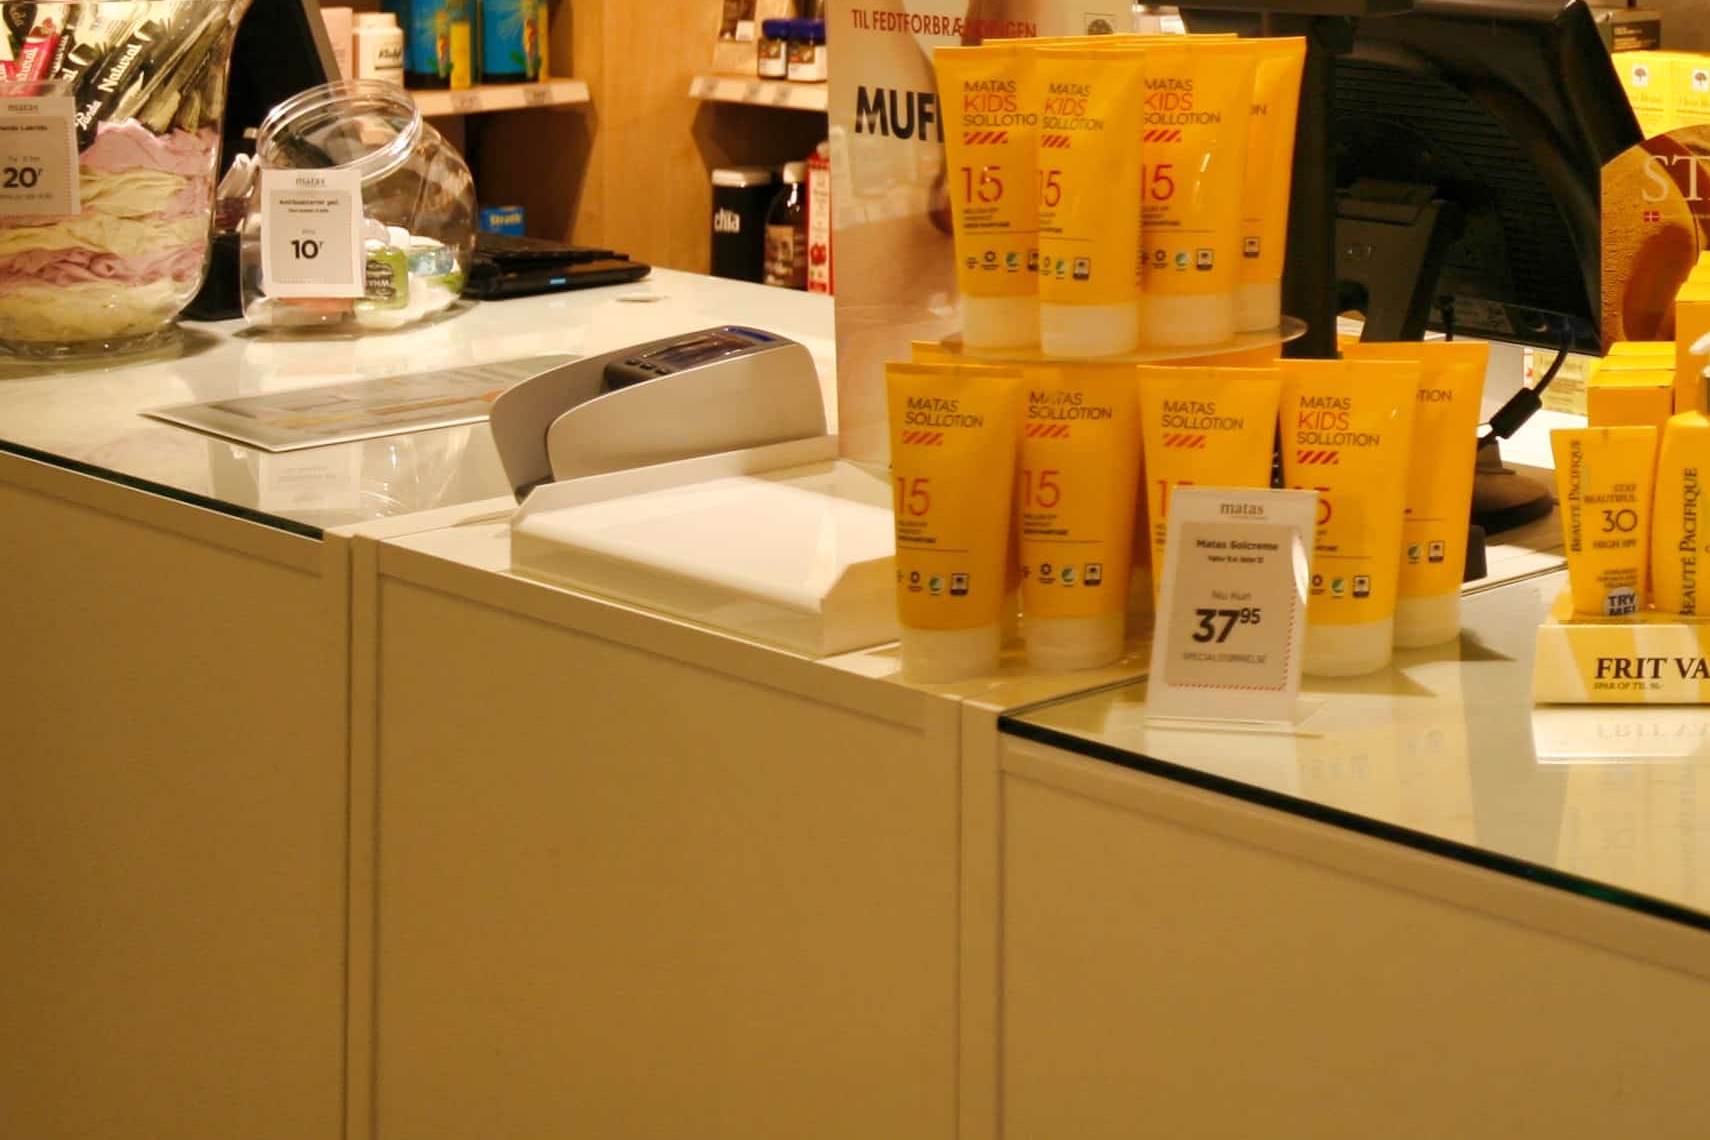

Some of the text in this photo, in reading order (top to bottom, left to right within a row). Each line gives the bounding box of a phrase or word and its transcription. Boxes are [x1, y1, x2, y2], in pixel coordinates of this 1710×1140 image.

[852, 9, 870, 29] TIL
[98, 43, 142, 92] Natural
[964, 81, 1016, 92] MATAS
[1049, 83, 1091, 97] MATAS
[964, 94, 1017, 113] KIDS
[1045, 98, 1088, 117] KIDS
[74, 100, 102, 130] Panda
[962, 113, 1038, 127] SOLLOTIO
[1042, 117, 1103, 131] SOLLOTION
[961, 166, 1003, 203] 15
[907, 398, 958, 412] MATAS
[1030, 392, 1082, 405] MATAS
[1300, 397, 1350, 410] MATAS
[1028, 405, 1112, 420] SOLLOTION
[1163, 401, 1215, 414] MATAS
[904, 412, 984, 427] SOLLOTION
[1161, 415, 1243, 430] SOLLOTION
[1299, 412, 1349, 430] KIDS
[1297, 433, 1379, 446] SOLLOTION
[897, 477, 931, 516] 15
[1023, 470, 1061, 508] 15
[1220, 502, 1264, 516] matas
[1679, 468, 1700, 552] PACIFIQUE
[1602, 510, 1638, 532] 30
[1608, 595, 1635, 608] TRY
[1597, 657, 1667, 679] FRIT
